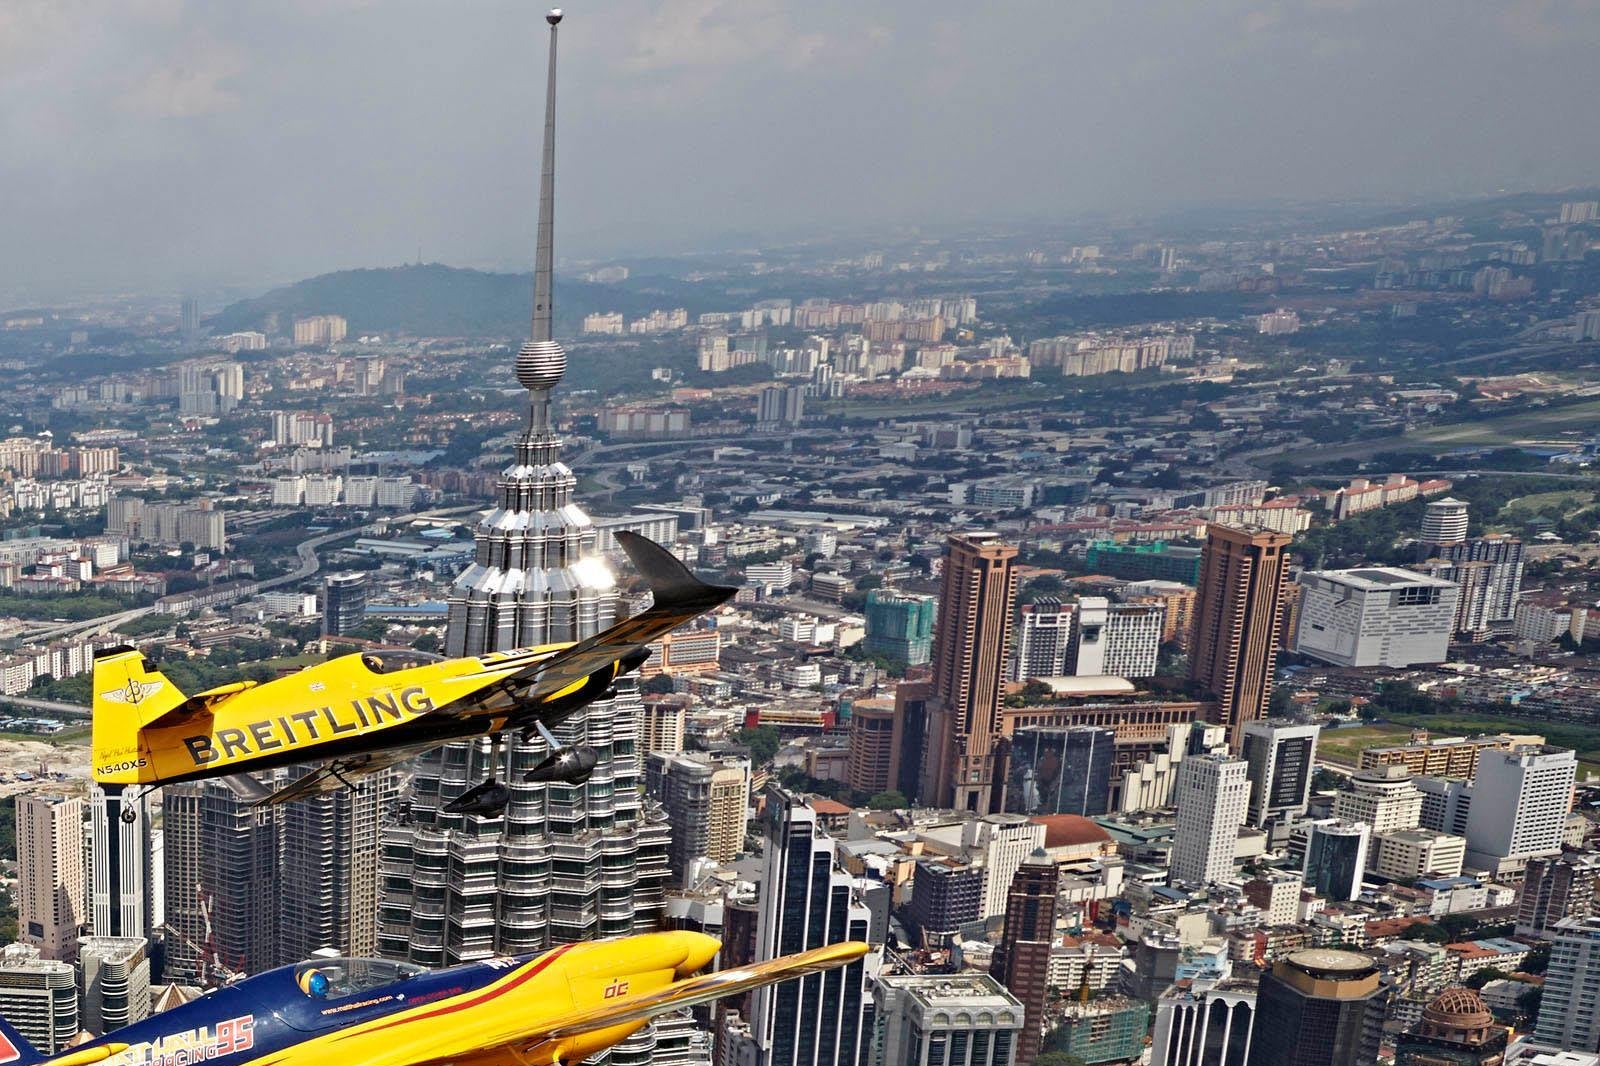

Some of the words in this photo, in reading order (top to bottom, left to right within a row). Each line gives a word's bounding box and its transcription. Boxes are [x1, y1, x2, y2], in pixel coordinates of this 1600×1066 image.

[183, 687, 434, 765] BREITLING
[97, 758, 147, 775] N540XS
[216, 1015, 253, 1055] 95
